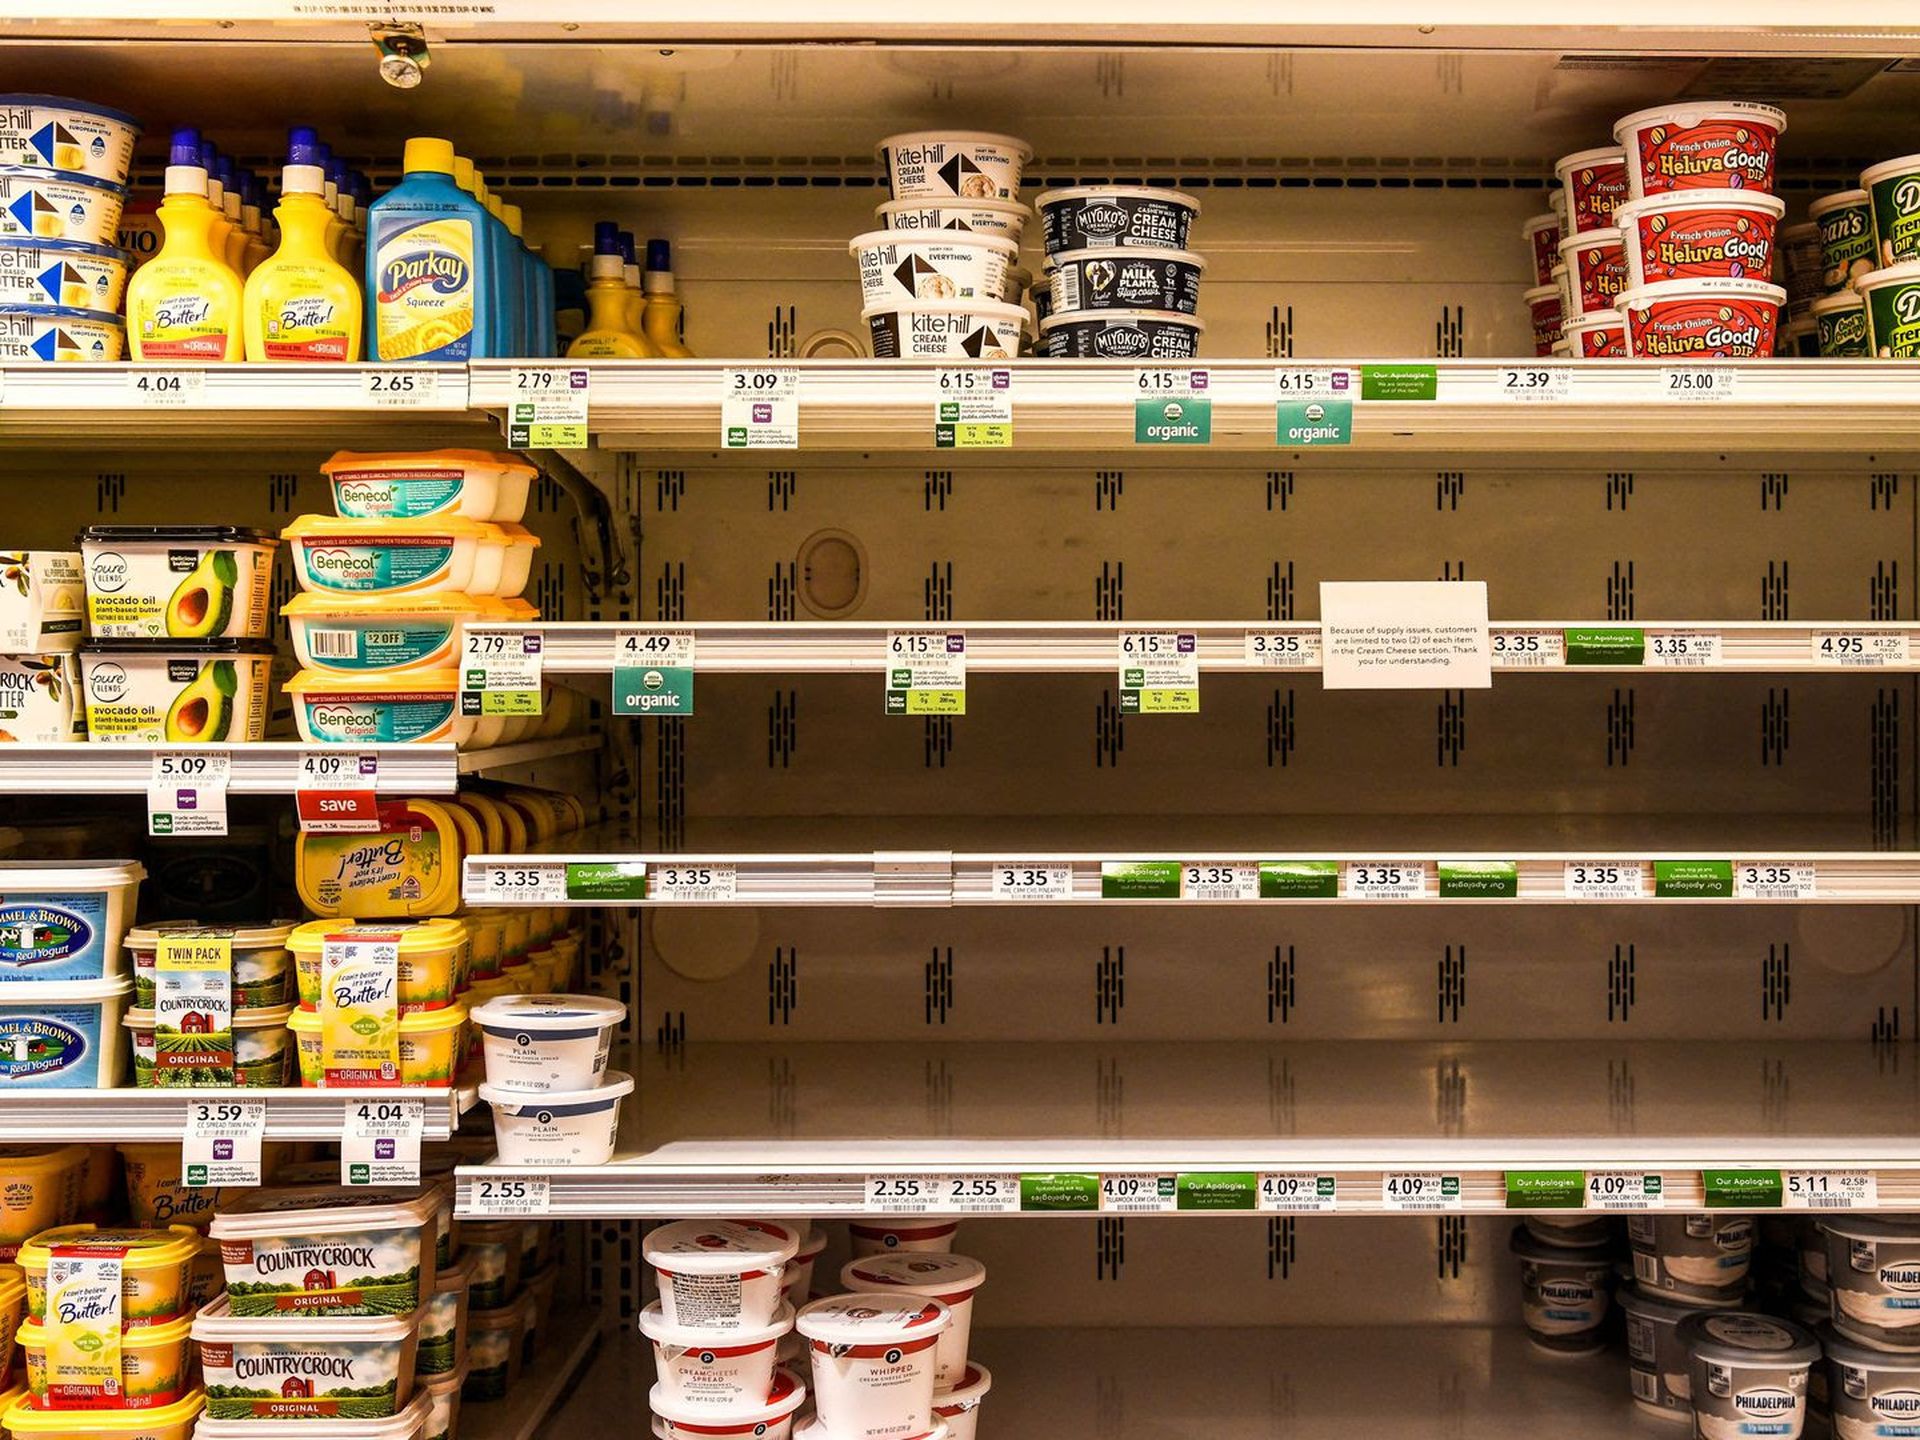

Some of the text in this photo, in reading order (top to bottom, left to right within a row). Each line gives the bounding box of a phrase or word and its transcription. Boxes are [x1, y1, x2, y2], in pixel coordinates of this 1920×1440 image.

[1670, 138, 1731, 152] French Onion
[1660, 148, 1768, 176] Heluva Good!
[898, 166, 926, 176] CREAM
[1747, 168, 1766, 182] DIP
[898, 174, 926, 186] CHEESE
[1078, 207, 1128, 227] MIYOKO'S
[1132, 213, 1177, 230] CREAM
[1131, 225, 1177, 242] CHEESE
[1670, 226, 1732, 240] French Onion
[1660, 238, 1769, 265] Heluva Good!
[1833, 240, 1873, 261] Onion
[388, 251, 464, 294] Parkay
[1122, 268, 1156, 280] MILK
[406, 296, 446, 308] Squeeze
[156, 303, 209, 329] Butter!
[280, 306, 334, 330] Butter!
[1654, 318, 1712, 332] French Onion
[912, 334, 948, 344] CREAM
[1097, 329, 1148, 349] MIYOKO'S
[1152, 336, 1190, 350] CREAM
[1646, 325, 1760, 355] Heluva Good!
[912, 344, 948, 354] CHEESE
[370, 376, 414, 391] 2.65
[518, 373, 552, 388] 2.79
[734, 374, 777, 388] 3.09
[940, 373, 974, 388] 6.15
[1138, 373, 1173, 388] 6.15
[1280, 374, 1314, 390] 6.15
[1390, 372, 1430, 380] Apologies
[1506, 372, 1550, 388] 2.39
[1670, 374, 1713, 390] 2/5.00
[137, 376, 182, 392] 4.04
[1148, 424, 1198, 440] organic
[1289, 424, 1340, 442] organic
[344, 489, 392, 502] Benecol
[92, 561, 128, 576] pure
[316, 556, 376, 570] Benecol
[342, 570, 375, 580] Original
[95, 595, 156, 606] avocado oil
[96, 606, 138, 614] plant-based
[1330, 626, 1478, 636] Because of supply issues, customers
[1576, 634, 1634, 642] Our Apologies
[383, 634, 400, 644] OFF
[469, 637, 504, 653] 2.79
[625, 637, 670, 652] 4.49
[892, 636, 928, 652] 6.15
[1123, 636, 1159, 652] 6.15
[1254, 637, 1299, 652] 3.35
[1350, 636, 1379, 644] limited
[1408, 636, 1420, 645] (2)
[1422, 636, 1432, 644] of
[1432, 636, 1452, 644] each
[1454, 636, 1474, 644] item
[1494, 636, 1539, 651] 3.35
[1654, 639, 1688, 654] 3.35
[1821, 638, 1863, 653] 4.95
[1332, 646, 1478, 654] in the Cream Cheese section. Thank
[1358, 658, 1374, 666] you
[1388, 656, 1450, 666] understanding.
[91, 672, 127, 686] pure
[626, 691, 680, 710] organic
[318, 712, 379, 726] Benecol
[344, 726, 377, 736] Original
[161, 758, 206, 774] 5.09
[304, 758, 340, 774] 4.09
[320, 798, 357, 812] save
[339, 840, 406, 879] Butter!
[494, 871, 540, 886] 3.35
[578, 870, 594, 878] Our
[666, 870, 711, 885] 3.35
[1003, 870, 1048, 886] 3.35
[1188, 868, 1233, 884] 3.35
[1356, 868, 1400, 884] 3.35
[1574, 868, 1618, 884] 3.35
[1746, 868, 1791, 884] 3.35
[1665, 882, 1704, 890] Apologies
[38, 909, 81, 934] BROWN
[16, 944, 69, 962] Real Yogurt
[168, 948, 221, 959] TWIN PACK
[342, 974, 358, 982] can't
[358, 970, 382, 980] believe
[334, 978, 391, 1008] Butter!
[32, 1021, 76, 1046] BROWN
[513, 1048, 536, 1056] PLAIN
[10, 1056, 64, 1074] Real Yogurt
[168, 1056, 220, 1064] ORIGINAL
[340, 1069, 378, 1080] ORIGINAL
[382, 1064, 394, 1072] 60
[197, 1105, 242, 1120] 3.59
[357, 1105, 404, 1120] 4.04
[874, 1180, 920, 1196] 2.55
[952, 1180, 997, 1196] 2.55
[1103, 1180, 1139, 1196] 4.09
[1188, 1182, 1246, 1190] Our Apologies
[1263, 1179, 1298, 1196] 4.09
[1388, 1178, 1423, 1195] 4.09
[1517, 1178, 1576, 1188] Our Apologies
[1590, 1178, 1624, 1194] 4.09
[1734, 1177, 1774, 1186] Apologies
[1789, 1176, 1828, 1192] 5.11
[480, 1182, 526, 1198] 2.55
[1030, 1194, 1070, 1202] Apologies
[294, 1295, 342, 1306] ORIGINAL
[58, 1294, 115, 1324] Butter!
[870, 1364, 913, 1376] WHIPPED
[63, 1386, 101, 1396] ORIGINAL
[270, 1404, 320, 1412] ORIGINAL
[1736, 1396, 1796, 1410] PHILADELPHIA
